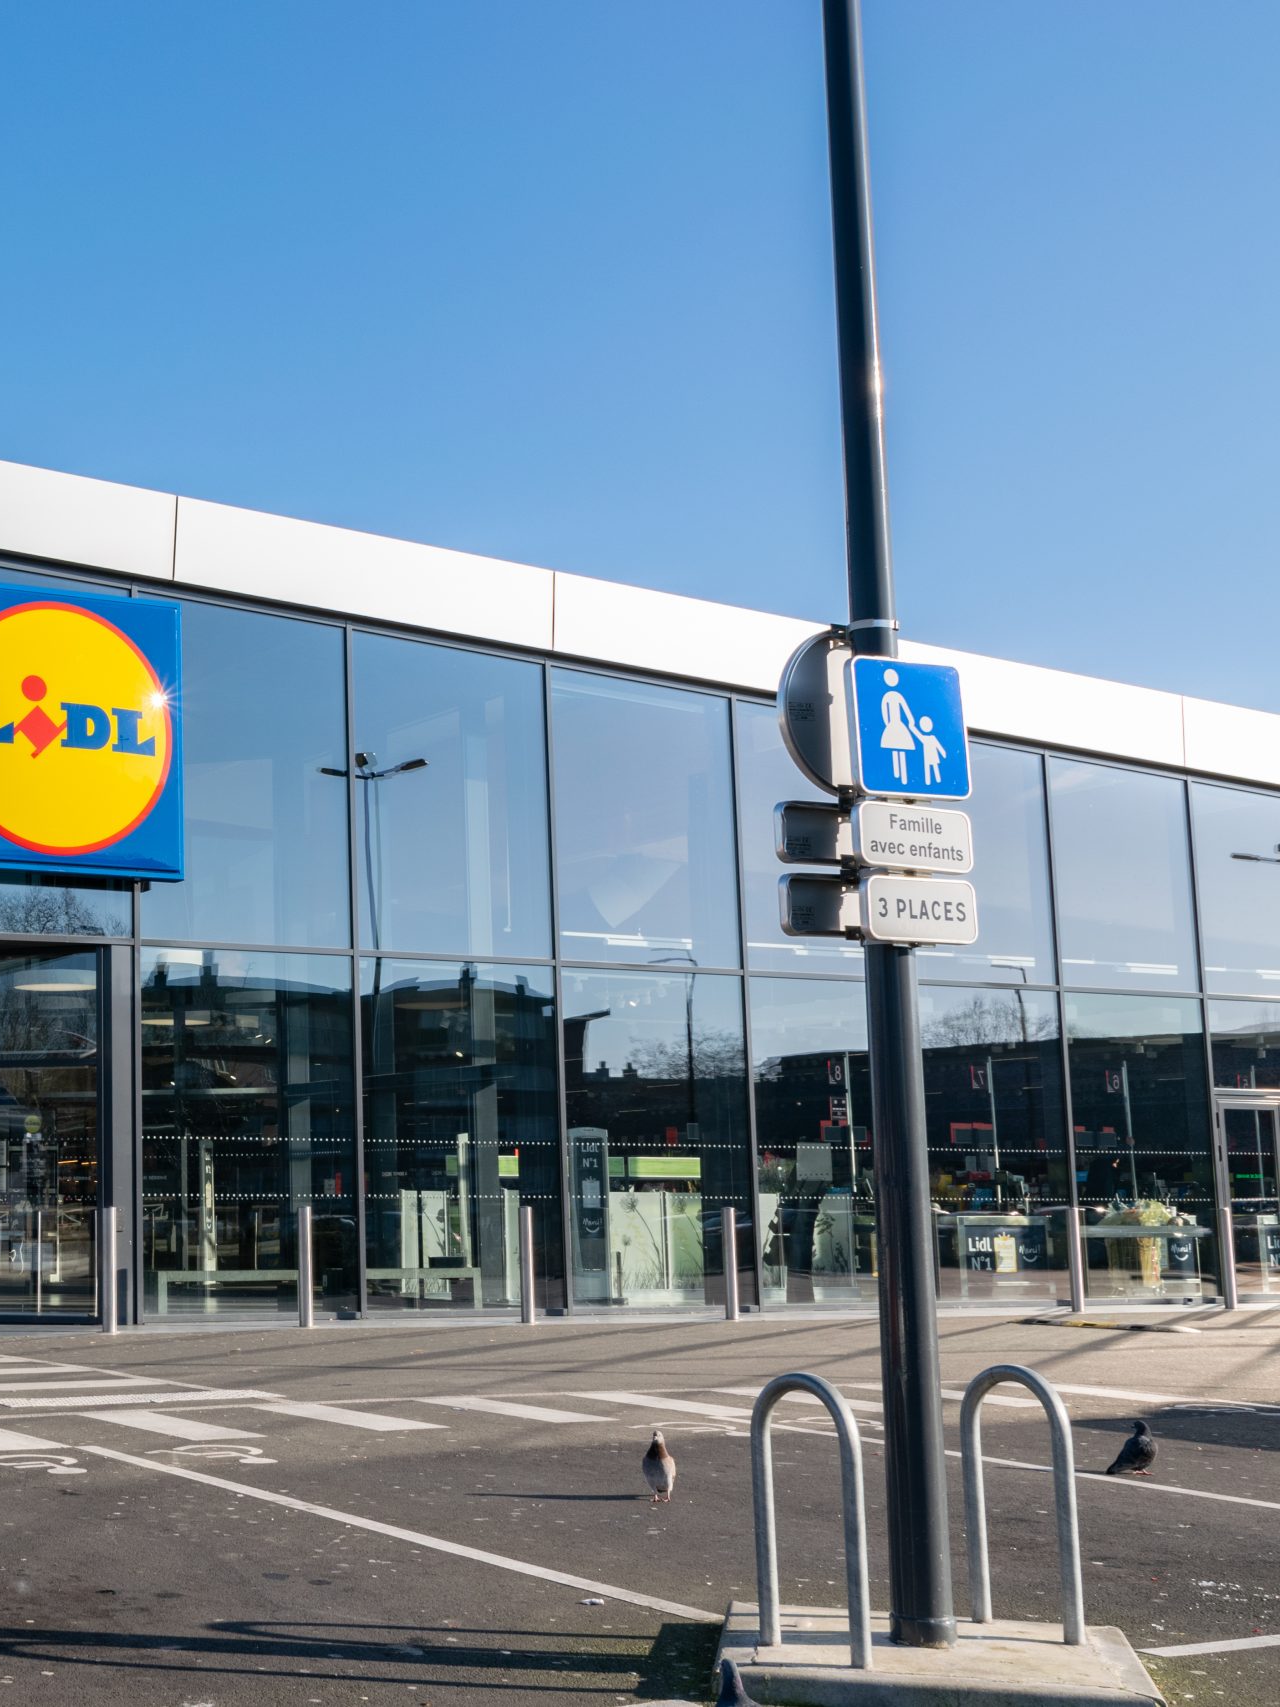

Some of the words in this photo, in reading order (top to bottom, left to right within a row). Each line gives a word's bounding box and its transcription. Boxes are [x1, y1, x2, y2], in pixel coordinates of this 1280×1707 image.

[889, 813, 942, 834] Famille
[870, 840, 905, 855] avec
[910, 842, 964, 861] enfants
[878, 897, 888, 918] 3
[896, 898, 966, 922] PLACES
[581, 1142, 599, 1153] Lidl
[968, 1236, 993, 1252] Lidl
[971, 1255, 993, 1271] N°1
